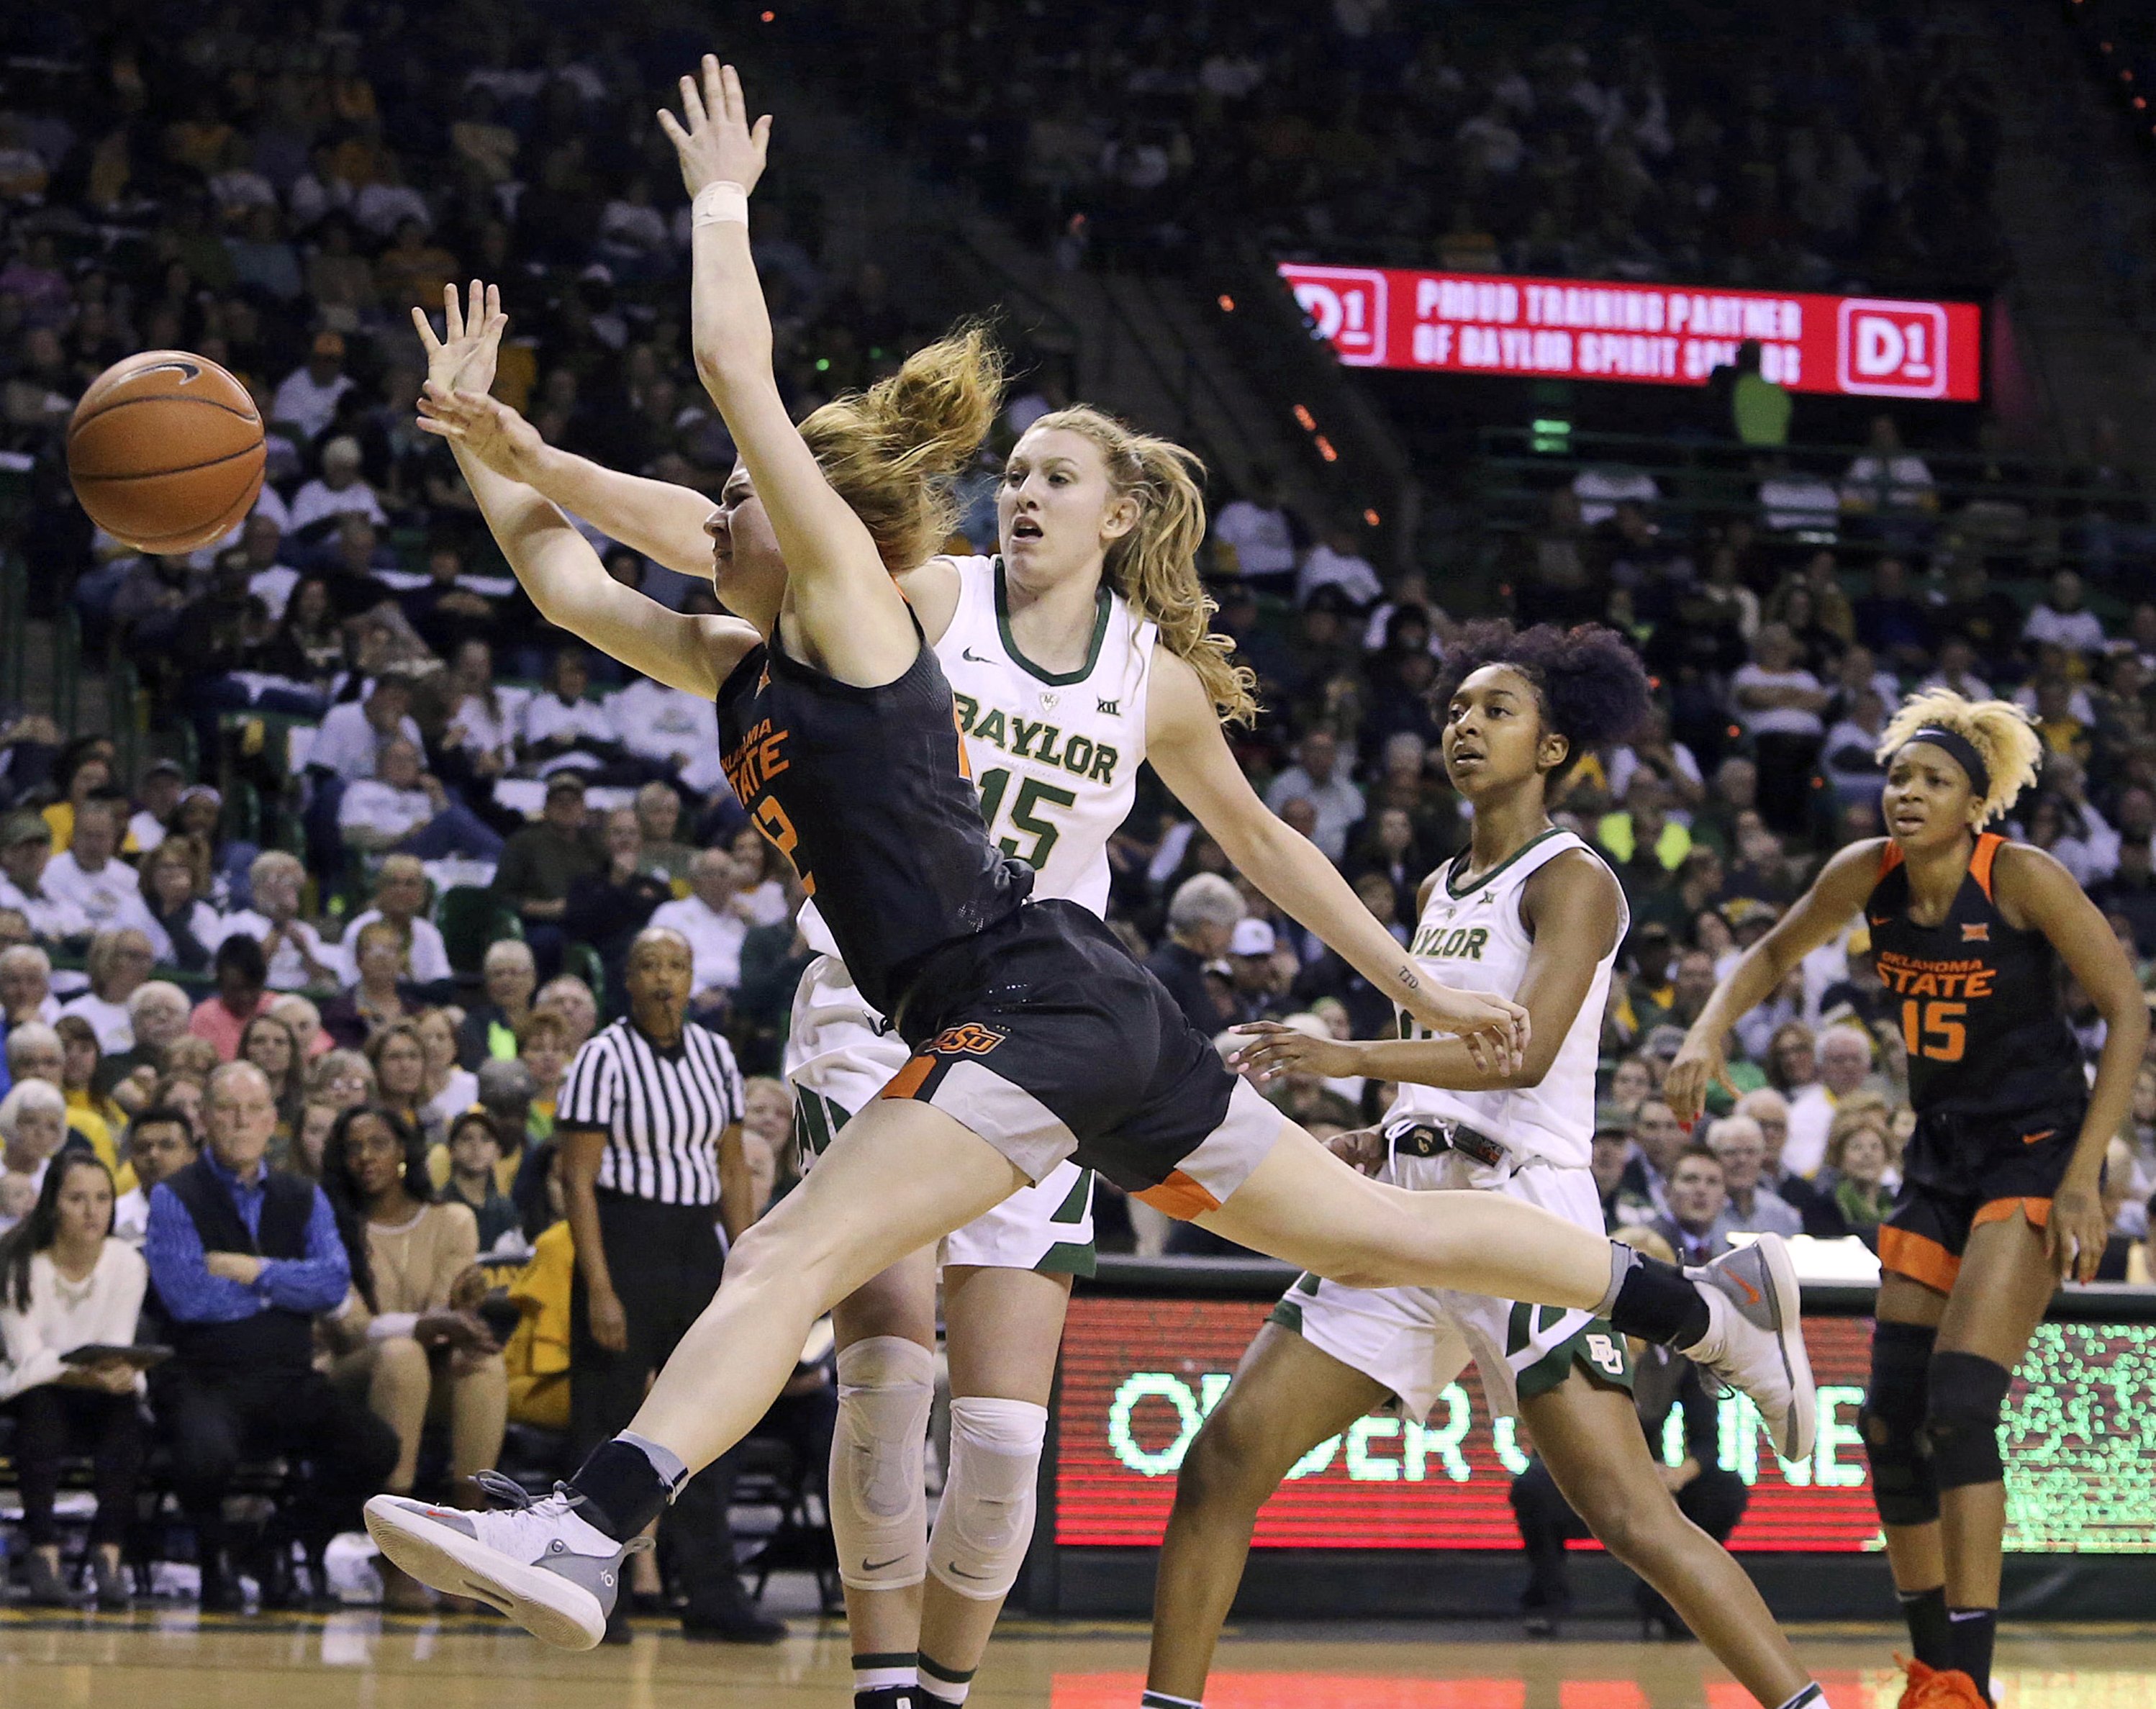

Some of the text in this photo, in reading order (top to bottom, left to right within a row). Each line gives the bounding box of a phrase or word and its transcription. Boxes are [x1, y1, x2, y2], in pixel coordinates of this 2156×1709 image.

[1418, 279, 1801, 340] PROUD TRAINING PARTNER
[1413, 324, 1452, 363] OF
[1460, 326, 1572, 371] BAYLOR
[1579, 333, 1678, 375] SPIRIT
[1856, 315, 1931, 378] D1
[954, 691, 1119, 786] BAYLOR
[726, 730, 790, 810] TATE
[977, 767, 1077, 873] 15
[1882, 951, 1984, 973] OKLAHOMA
[1902, 999, 1967, 1061] 15
